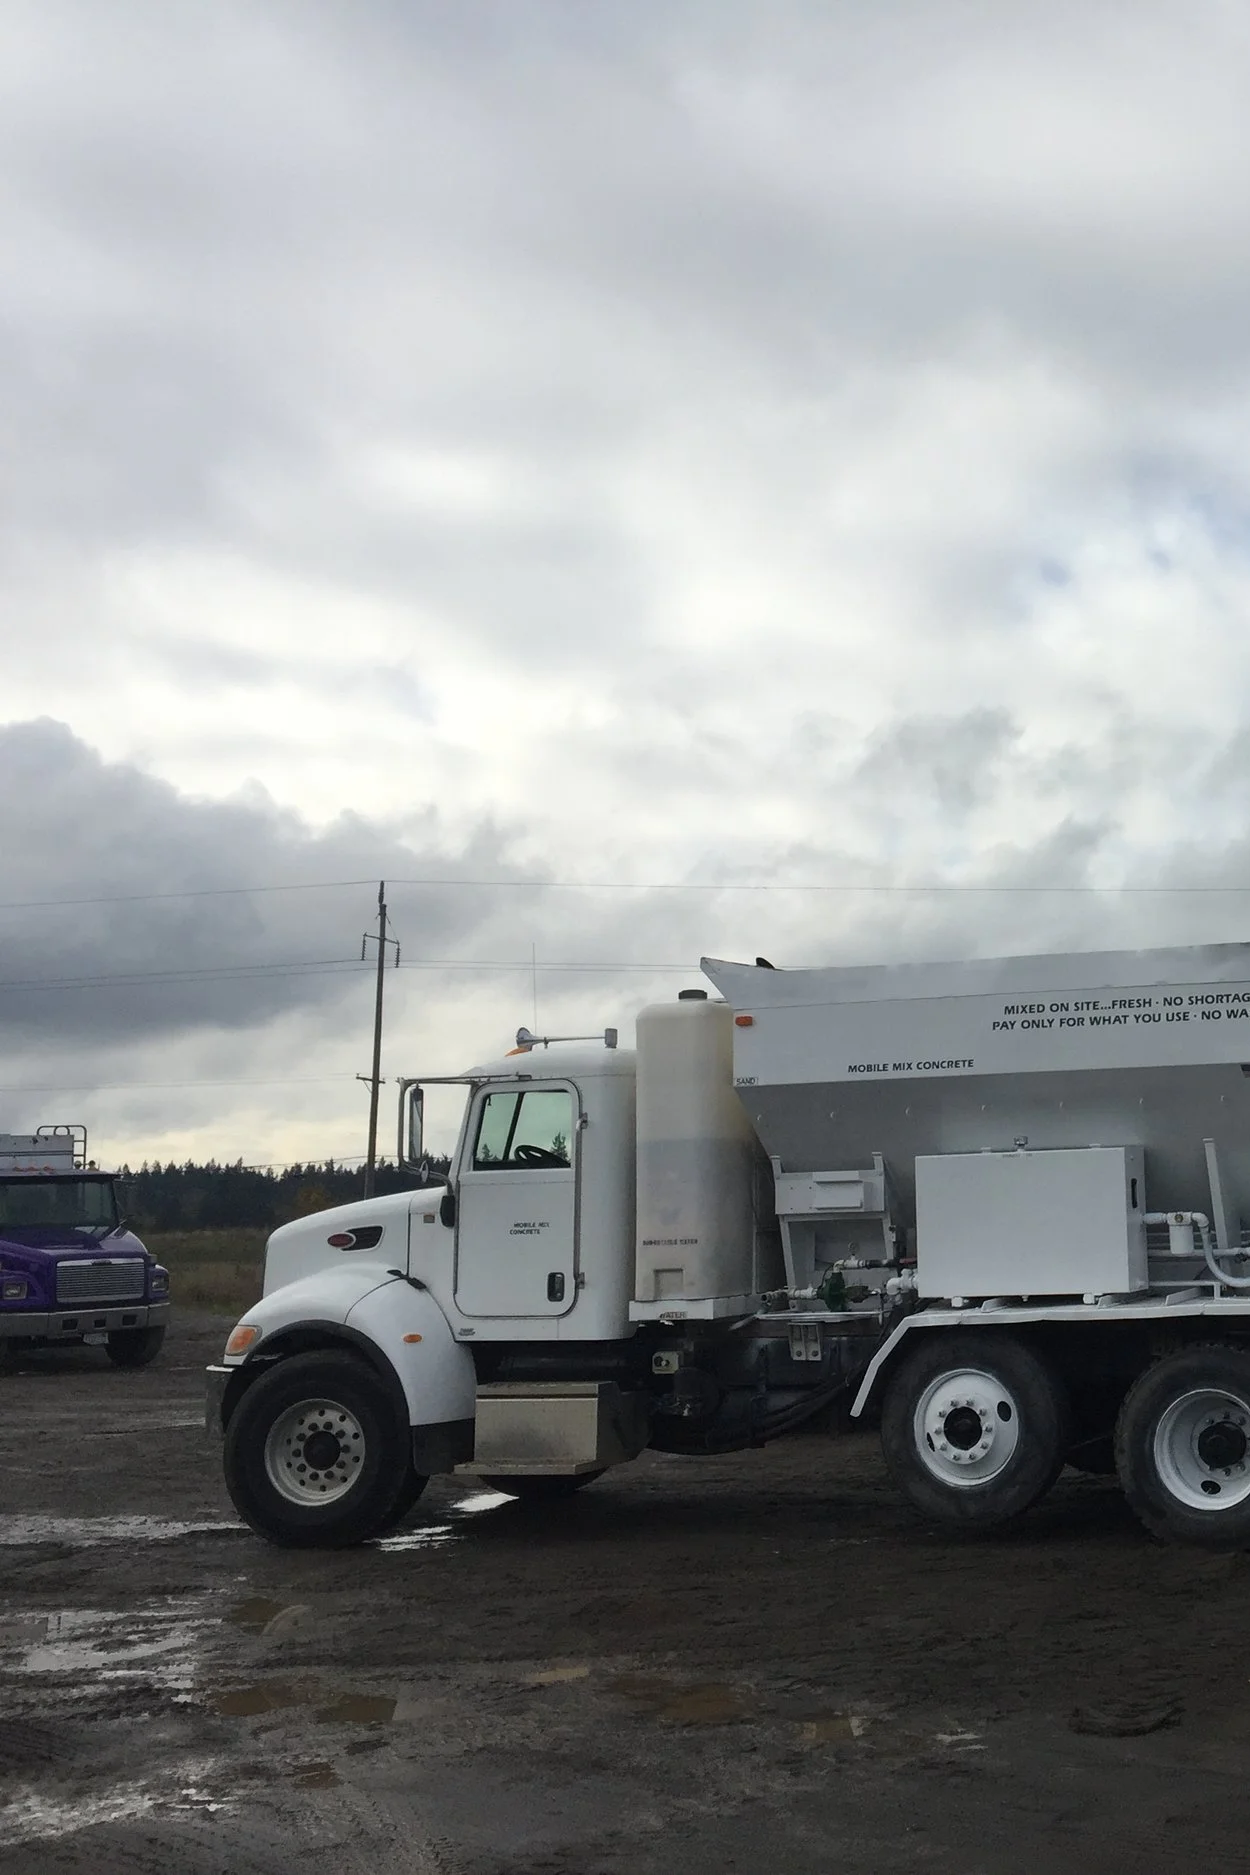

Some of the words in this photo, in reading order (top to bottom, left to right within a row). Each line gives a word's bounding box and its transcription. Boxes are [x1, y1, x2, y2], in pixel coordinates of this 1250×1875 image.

[1004, 1004, 1045, 1015] MIXED
[1049, 1002, 1070, 1013] ON
[1163, 996, 1184, 1007] NO
[992, 1020, 1016, 1031] PAY
[1020, 1018, 1055, 1029] ONLY
[1059, 1017, 1085, 1028] FOR
[1089, 1014, 1130, 1026] WHAT
[1134, 1013, 1161, 1024] YOU
[1166, 1011, 1190, 1022] USE
[1201, 1010, 1222, 1020] NO
[848, 1063, 889, 1073] MOBILE
[892, 1062, 913, 1071] MIX
[916, 1059, 975, 1070] CONCRETE
[736, 1077, 756, 1086] SAND
